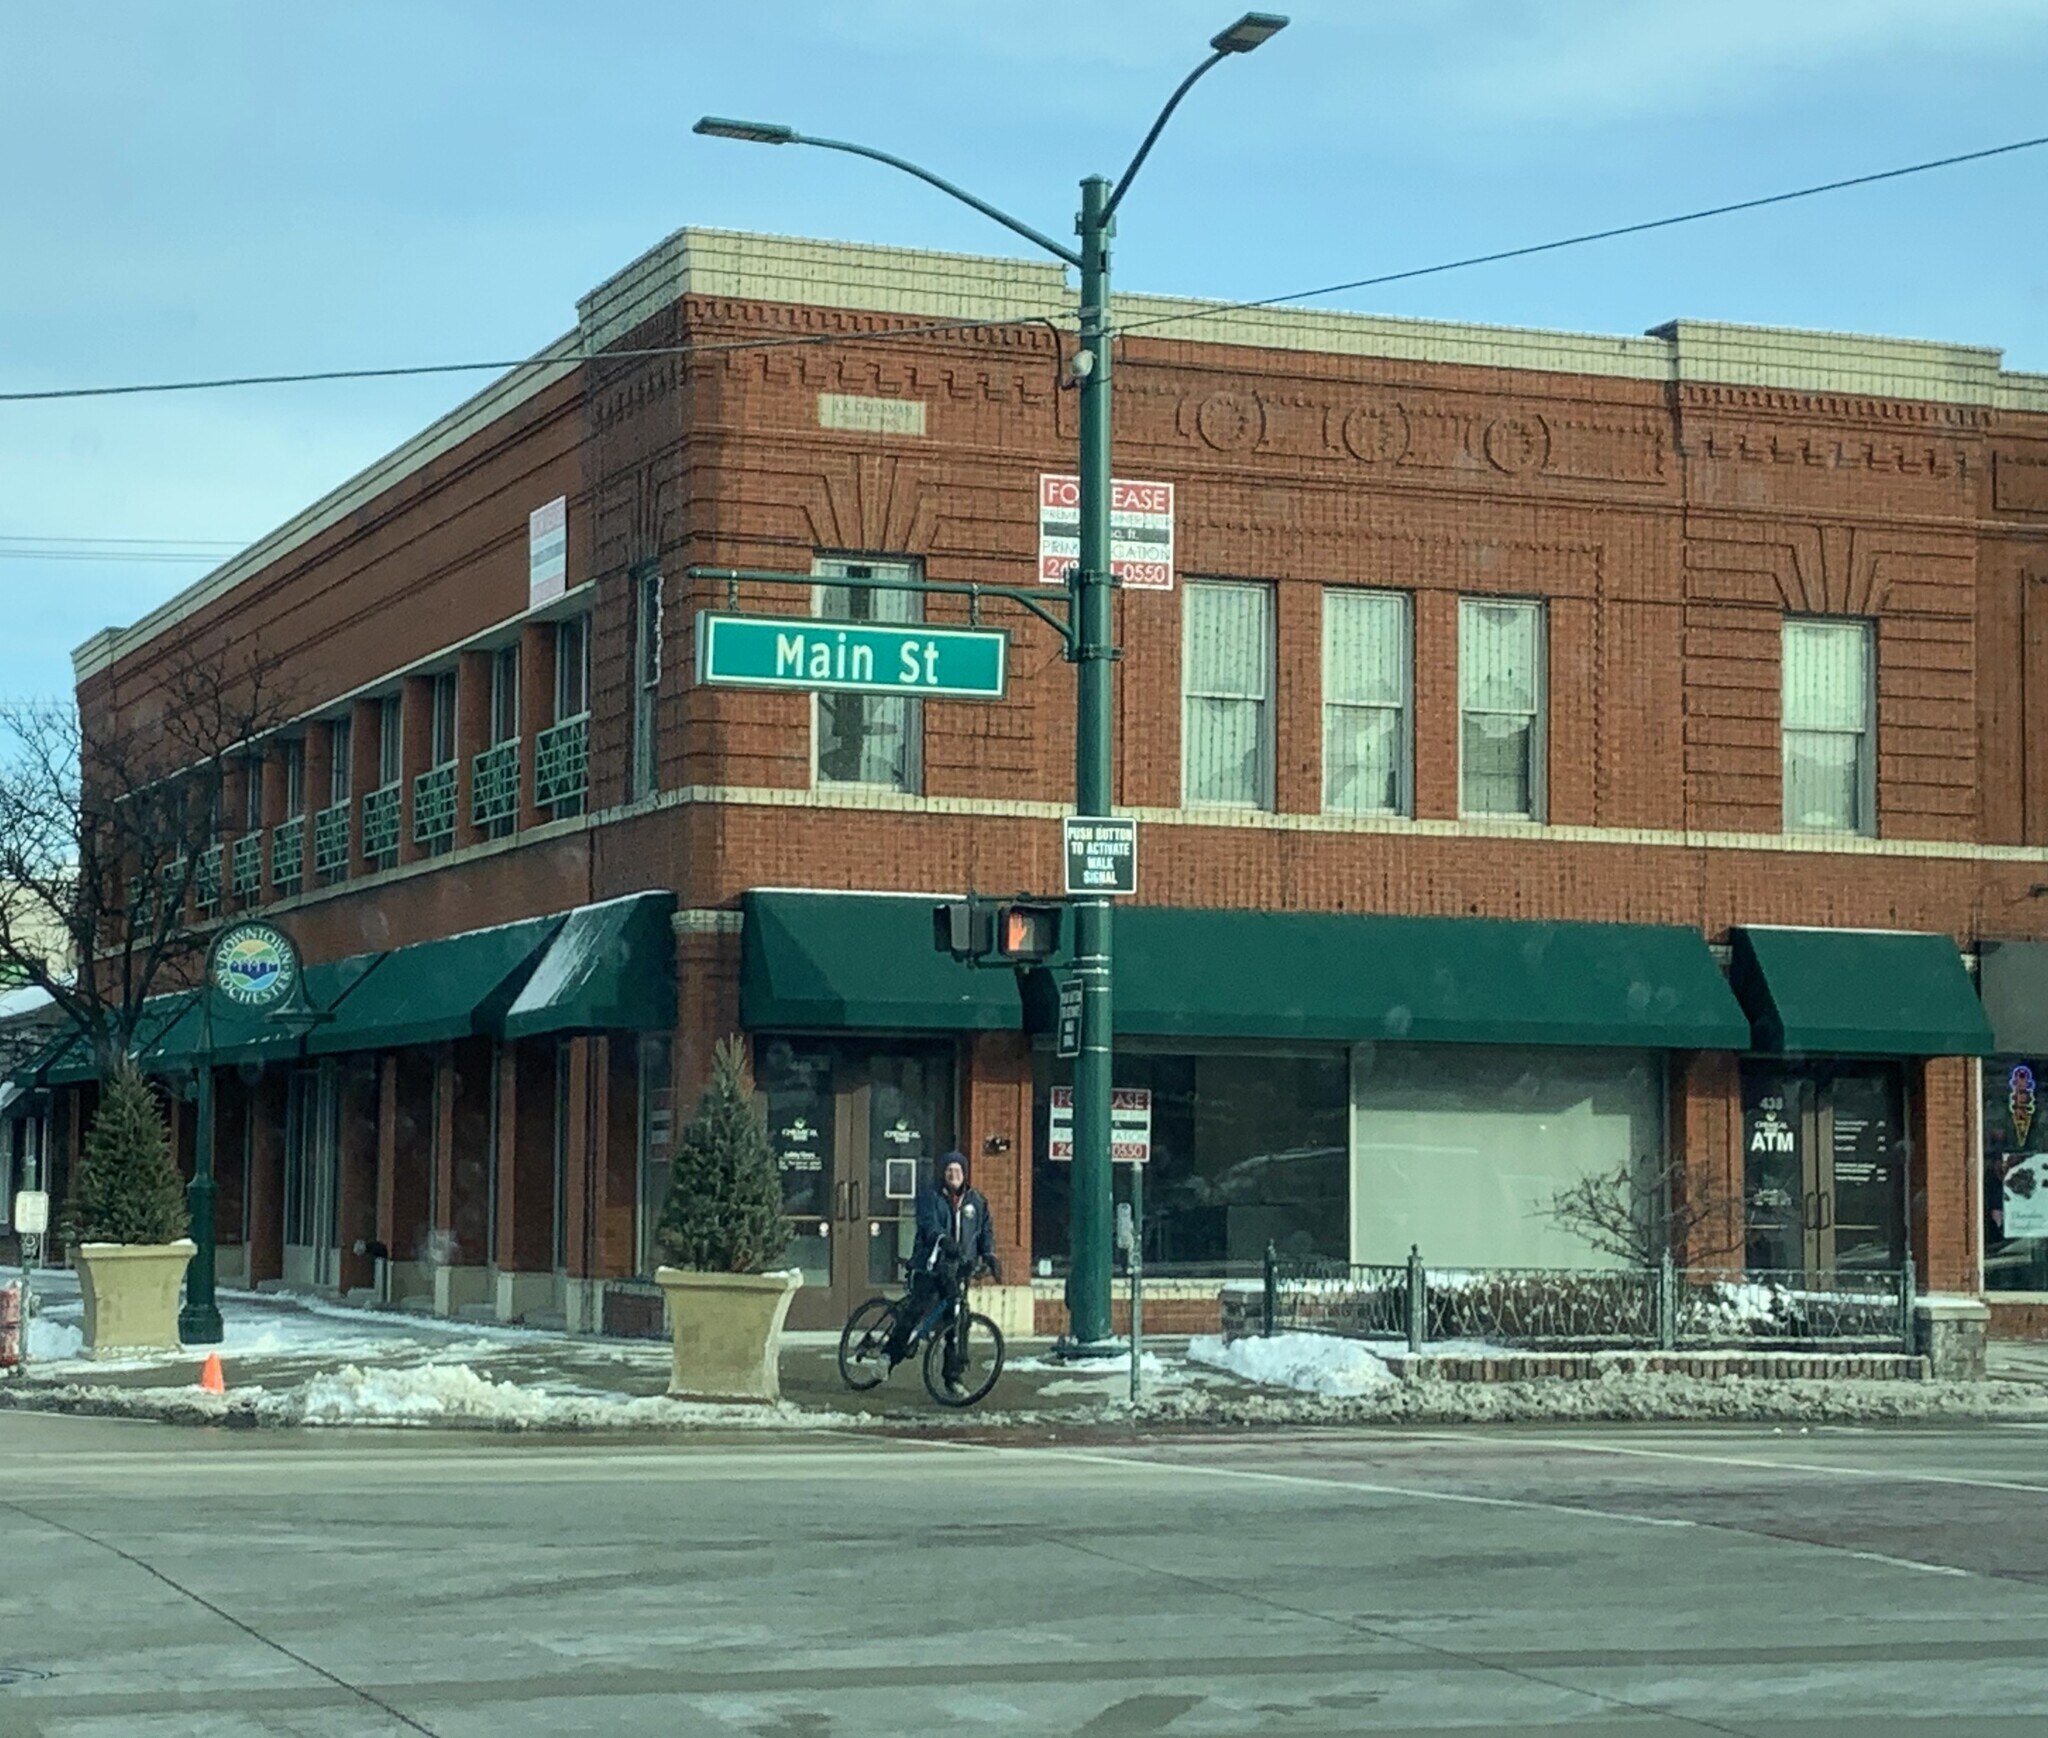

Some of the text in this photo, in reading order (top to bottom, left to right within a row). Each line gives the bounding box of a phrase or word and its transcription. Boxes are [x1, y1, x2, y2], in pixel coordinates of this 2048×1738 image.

[1048, 482, 1166, 511] FO EASE
[1043, 540, 1170, 563] PRIM CATION
[776, 632, 939, 685] Main St
[1068, 827, 1133, 841] PUSH BUTTON
[1071, 842, 1130, 855] TO ACTIVATE
[1087, 856, 1114, 869] WALK
[1083, 870, 1118, 884] SIGNAL
[216, 927, 292, 965] DOWNTOWN
[216, 968, 292, 1005] ROCHESTER
[1751, 1131, 1794, 1151] ATM
